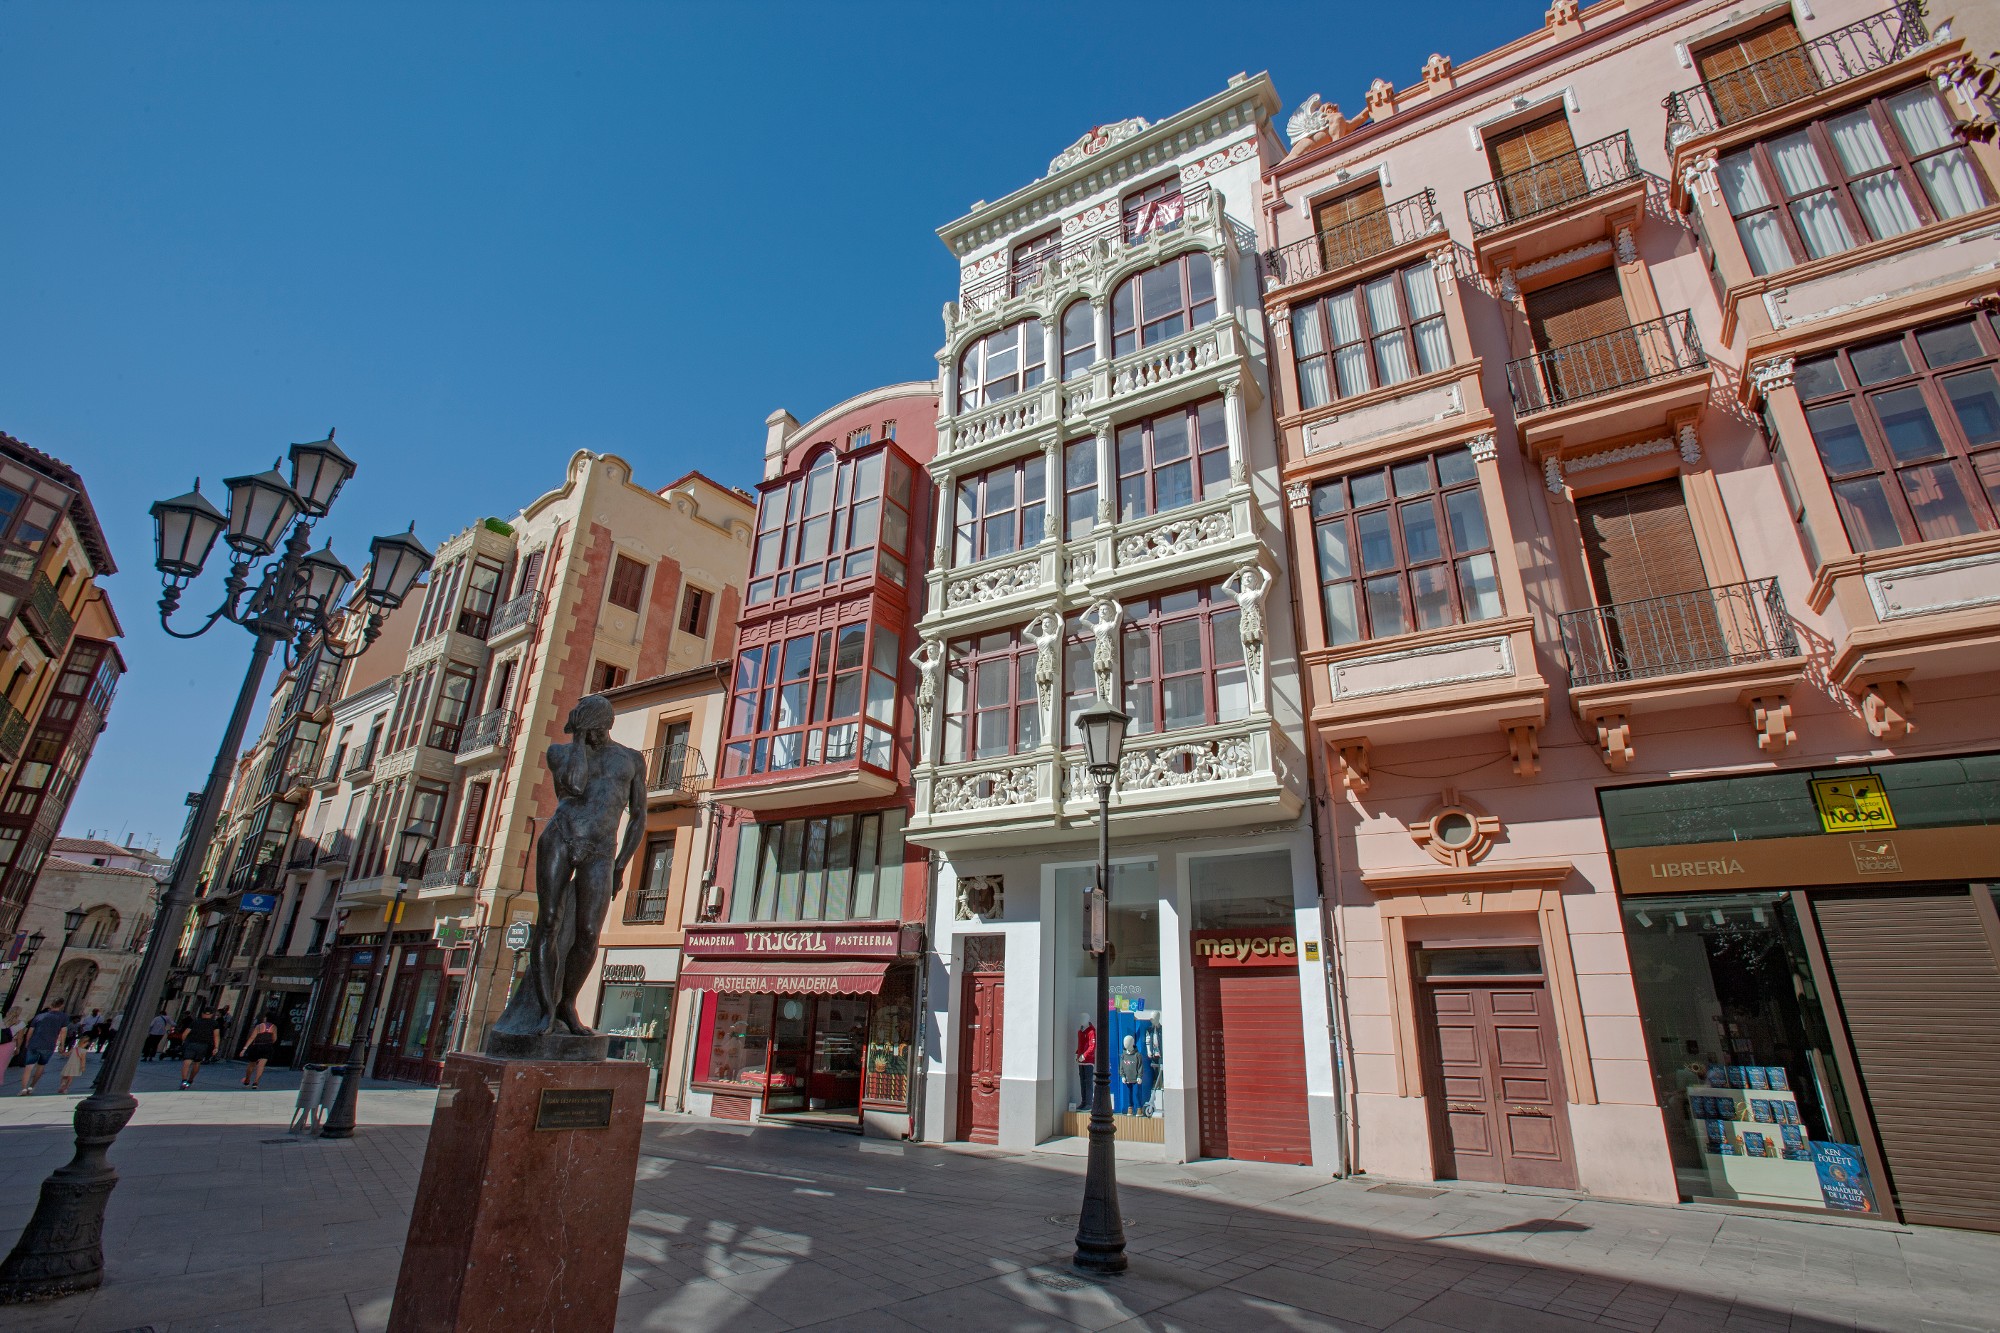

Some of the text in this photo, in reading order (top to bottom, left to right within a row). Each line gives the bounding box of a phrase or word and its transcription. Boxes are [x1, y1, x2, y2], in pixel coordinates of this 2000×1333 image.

[1829, 807, 1885, 824] Nobel
[1650, 856, 1745, 878] LIBRERÍA
[1859, 859, 1898, 871] Nobel
[1461, 891, 1472, 906] 4
[688, 935, 736, 947] PANADERIA
[834, 935, 894, 947] PASTELERIA
[1195, 936, 1297, 962] mayora
[603, 964, 646, 981] SOBRINO
[713, 977, 767, 990] PASTELERIA
[776, 977, 839, 991] PANADERIA
[1108, 983, 1128, 994] ack
[1823, 1147, 1841, 1157] KEN
[1817, 1153, 1852, 1167] FOLLETT
[1823, 1184, 1866, 1197] ARMADURA
[1828, 1191, 1838, 1199] DE
[1848, 1195, 1863, 1203] LUZ
